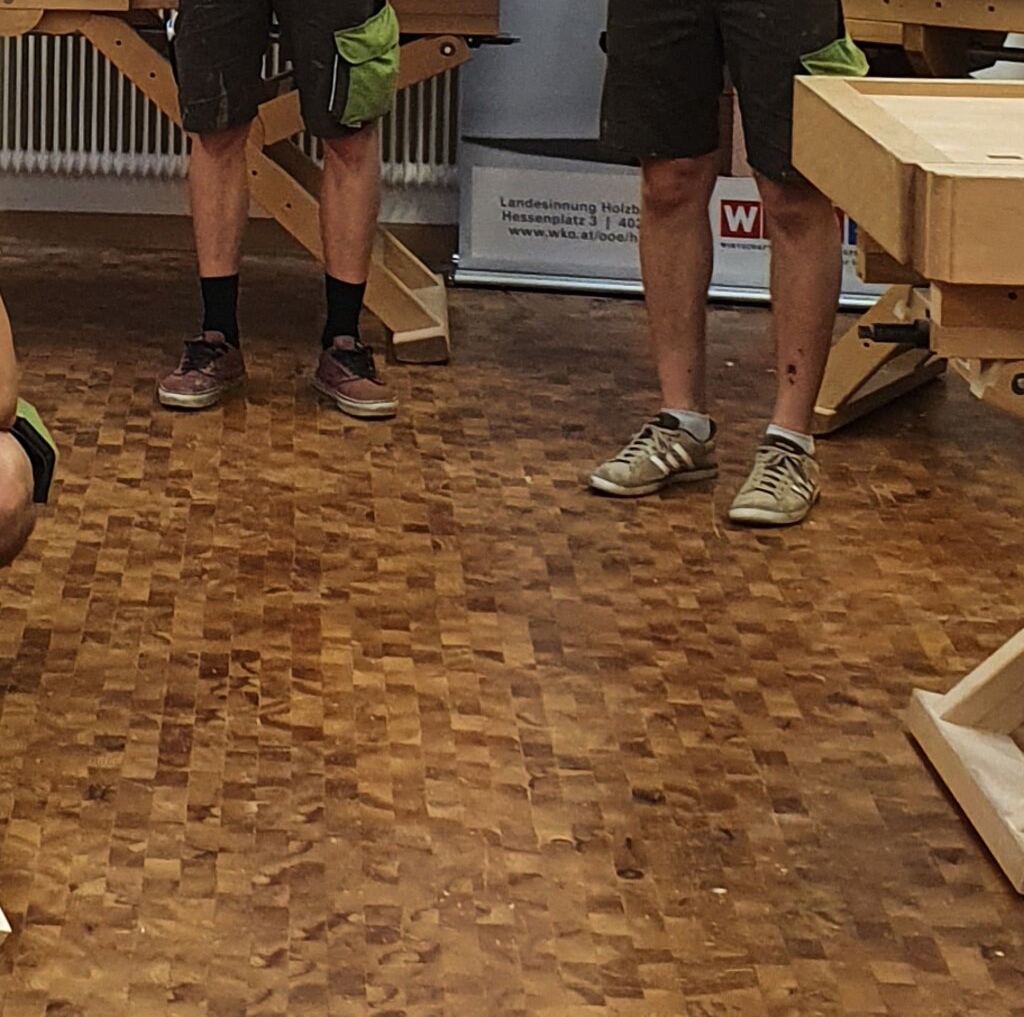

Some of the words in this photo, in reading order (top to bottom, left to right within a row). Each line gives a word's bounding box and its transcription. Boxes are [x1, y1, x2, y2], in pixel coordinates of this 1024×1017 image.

[500, 196, 596, 214] Landesinnung
[502, 210, 585, 225] Hessenplatz
[590, 215, 597, 226] 3
[723, 205, 758, 232] W
